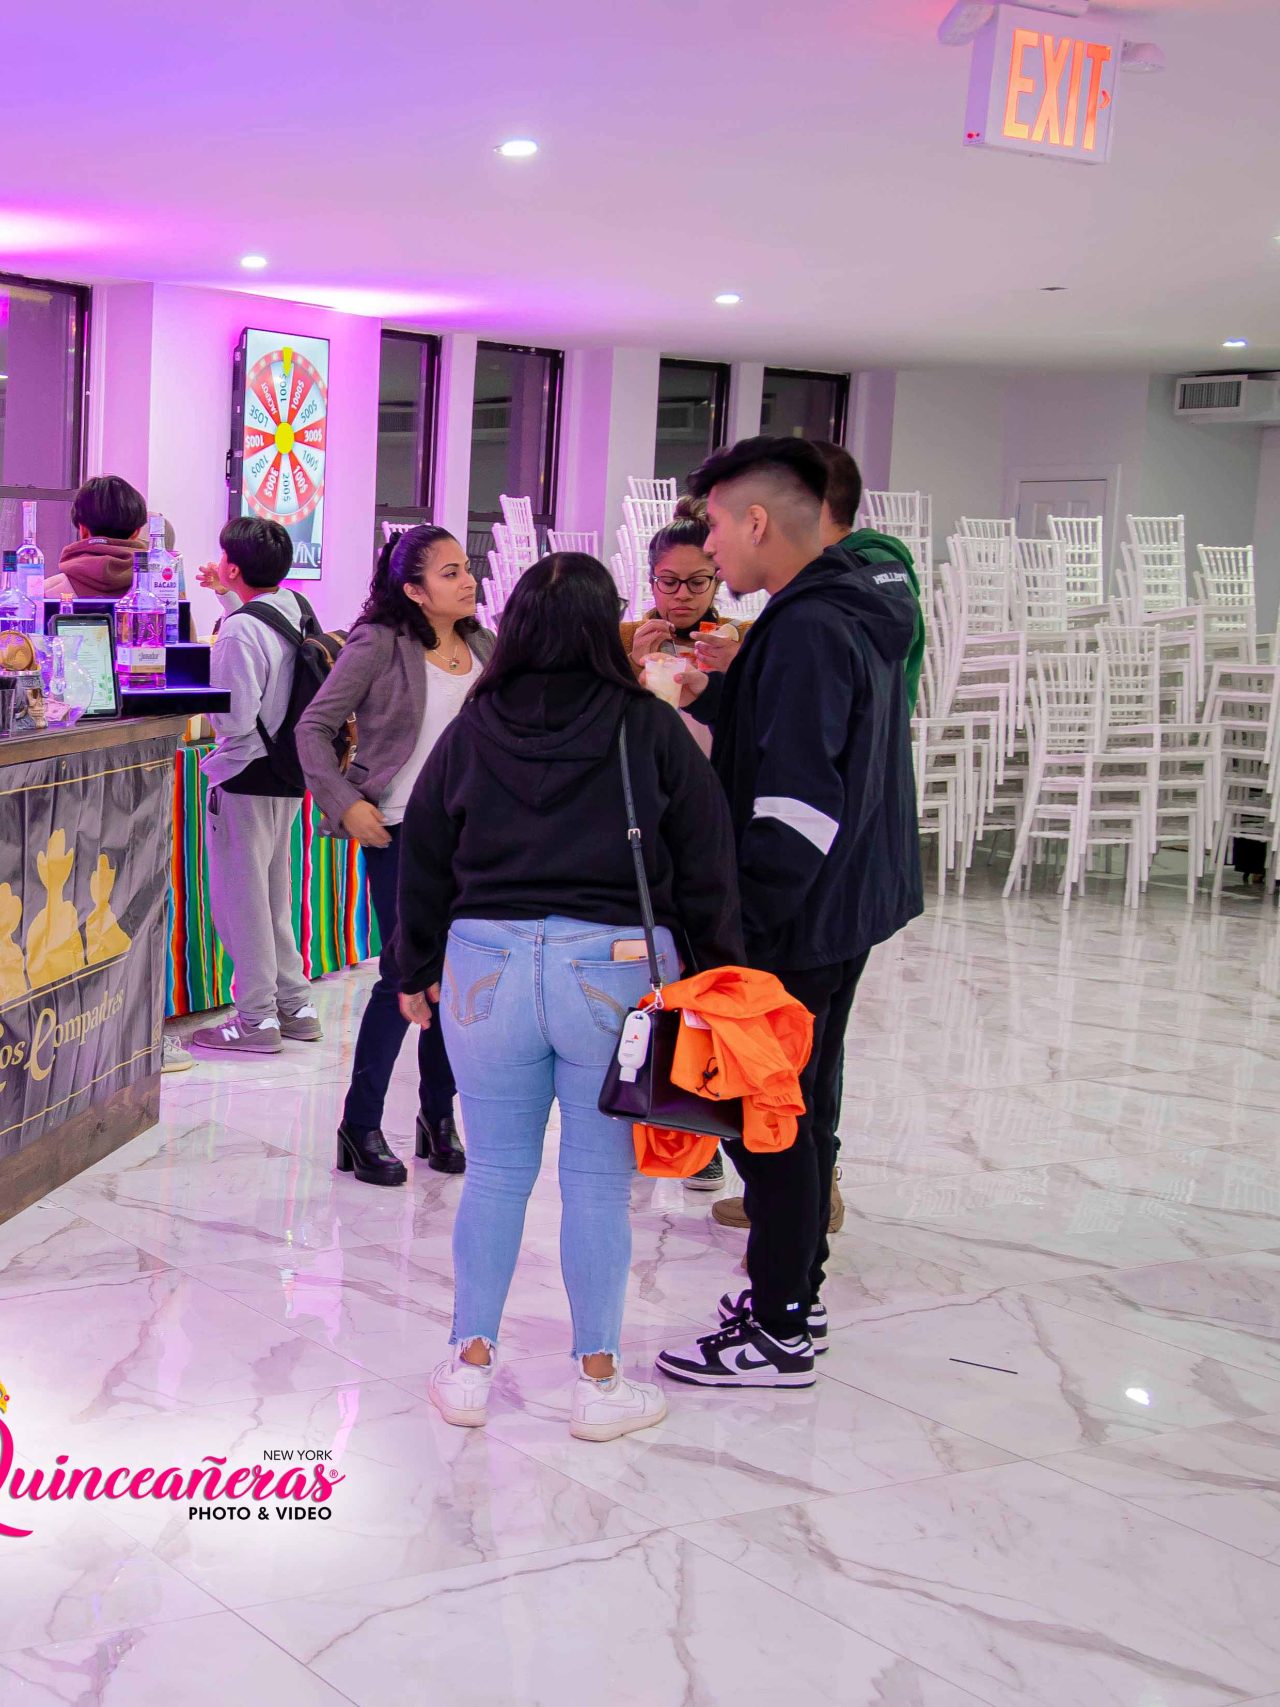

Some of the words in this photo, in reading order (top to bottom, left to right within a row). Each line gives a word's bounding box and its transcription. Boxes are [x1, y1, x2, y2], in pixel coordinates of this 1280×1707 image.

[1003, 28, 1111, 151] EXIT
[261, 382, 278, 415] JACKPOT
[249, 404, 269, 428] LOSE
[221, 1026, 240, 1042] N
